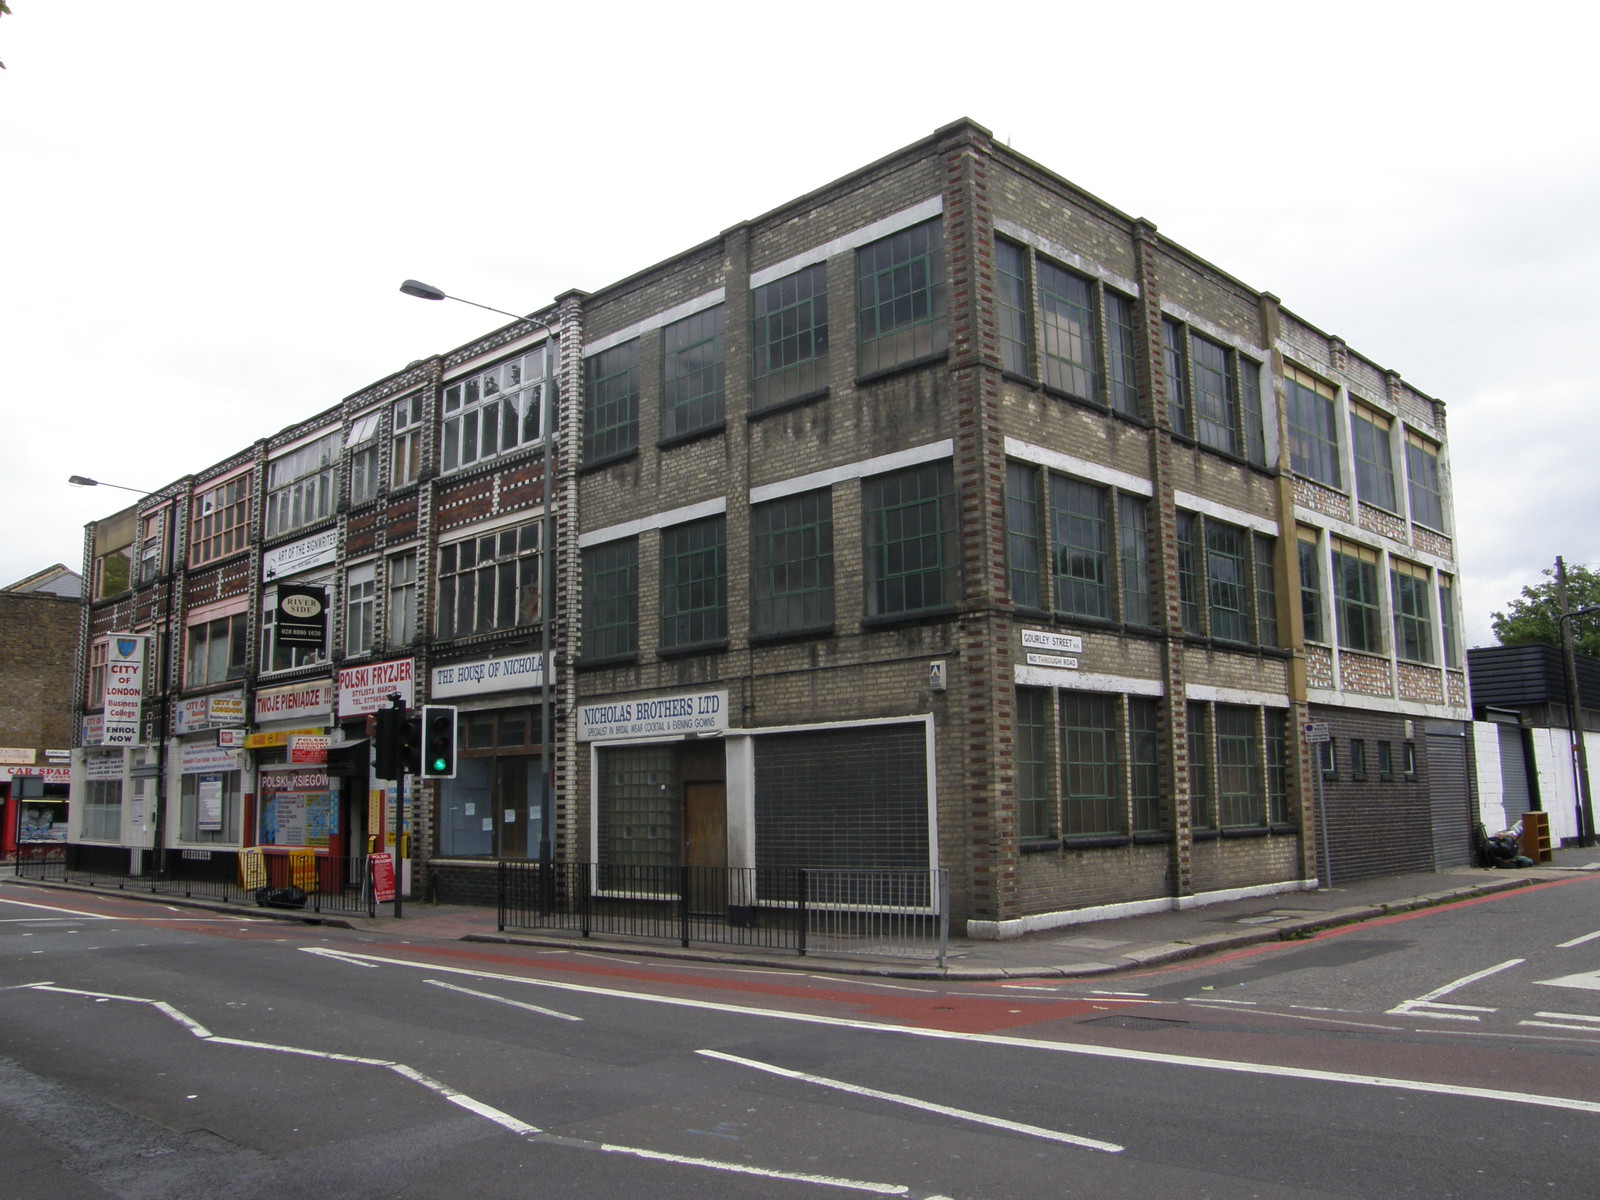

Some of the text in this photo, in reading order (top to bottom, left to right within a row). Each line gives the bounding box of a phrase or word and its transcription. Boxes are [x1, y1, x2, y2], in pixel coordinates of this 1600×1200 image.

[278, 532, 336, 562] ART OF THE SIGNWRITER
[287, 598, 316, 606] RIVER
[290, 606, 312, 614] SIDE
[1024, 633, 1072, 648] GOURLEY STREET
[1028, 654, 1076, 667] NO THROUGH ROAD
[111, 664, 139, 674] CITY
[438, 656, 544, 684] THE HOUSE OF NICHOLA
[339, 661, 411, 690] POLSKI FRYZJER
[107, 687, 141, 696] LONDON
[352, 688, 375, 698] STYLISTA
[108, 700, 138, 708] Business
[186, 701, 198, 711] CITY
[257, 694, 280, 714] TWOJE
[280, 688, 320, 710] PIENIĄDZE
[110, 709, 136, 719] College
[584, 695, 720, 725] NICHOLAS BROTHERS LTD
[587, 716, 715, 737] SPECIALIST IN BRIDAL WEAR COCKTAIL & EVENING GOWNS
[262, 776, 288, 787] POLSKI
